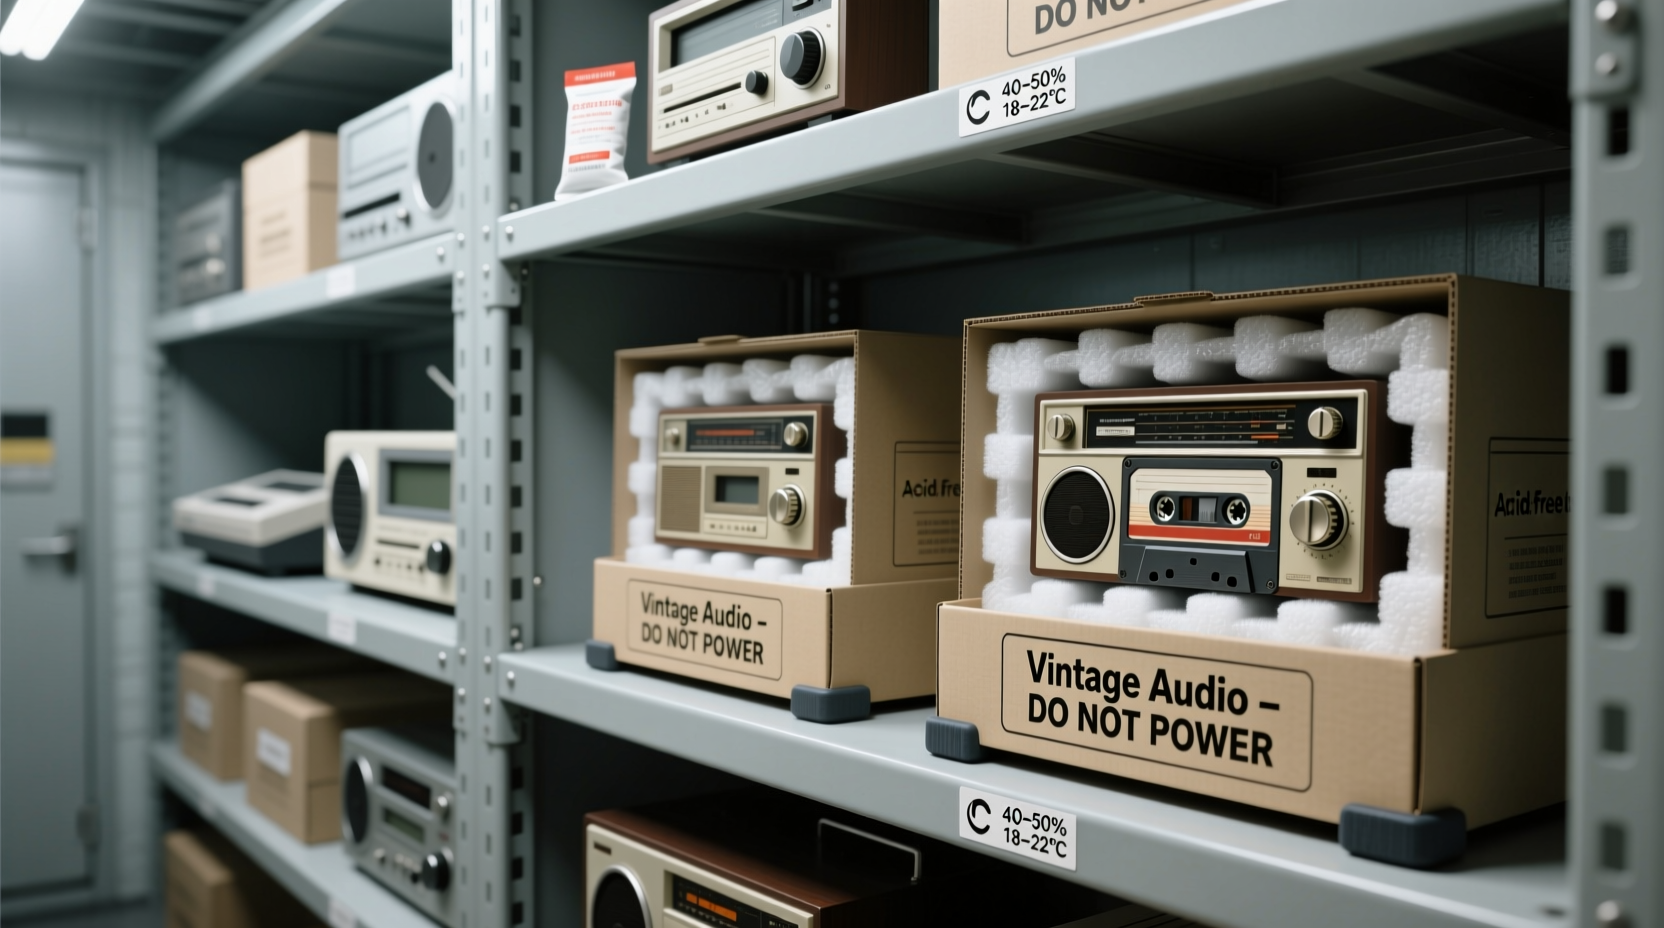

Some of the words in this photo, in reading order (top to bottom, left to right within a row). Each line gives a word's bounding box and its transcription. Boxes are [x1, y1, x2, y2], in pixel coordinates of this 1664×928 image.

[1035, 0, 1077, 35] DO
[1002, 66, 1066, 97] 40–50%
[641, 591, 698, 626] Vintage
[702, 601, 752, 630] Audio
[642, 622, 662, 644] DO
[667, 626, 698, 651] NOT
[703, 633, 763, 665] POWER
[1027, 650, 1140, 703] Vintage
[1148, 668, 1248, 715] Audio
[1028, 692, 1069, 728] DO
[1078, 701, 1141, 741] NOT
[1150, 713, 1273, 767] POWER
[1002, 806, 1067, 837] 40–50%
